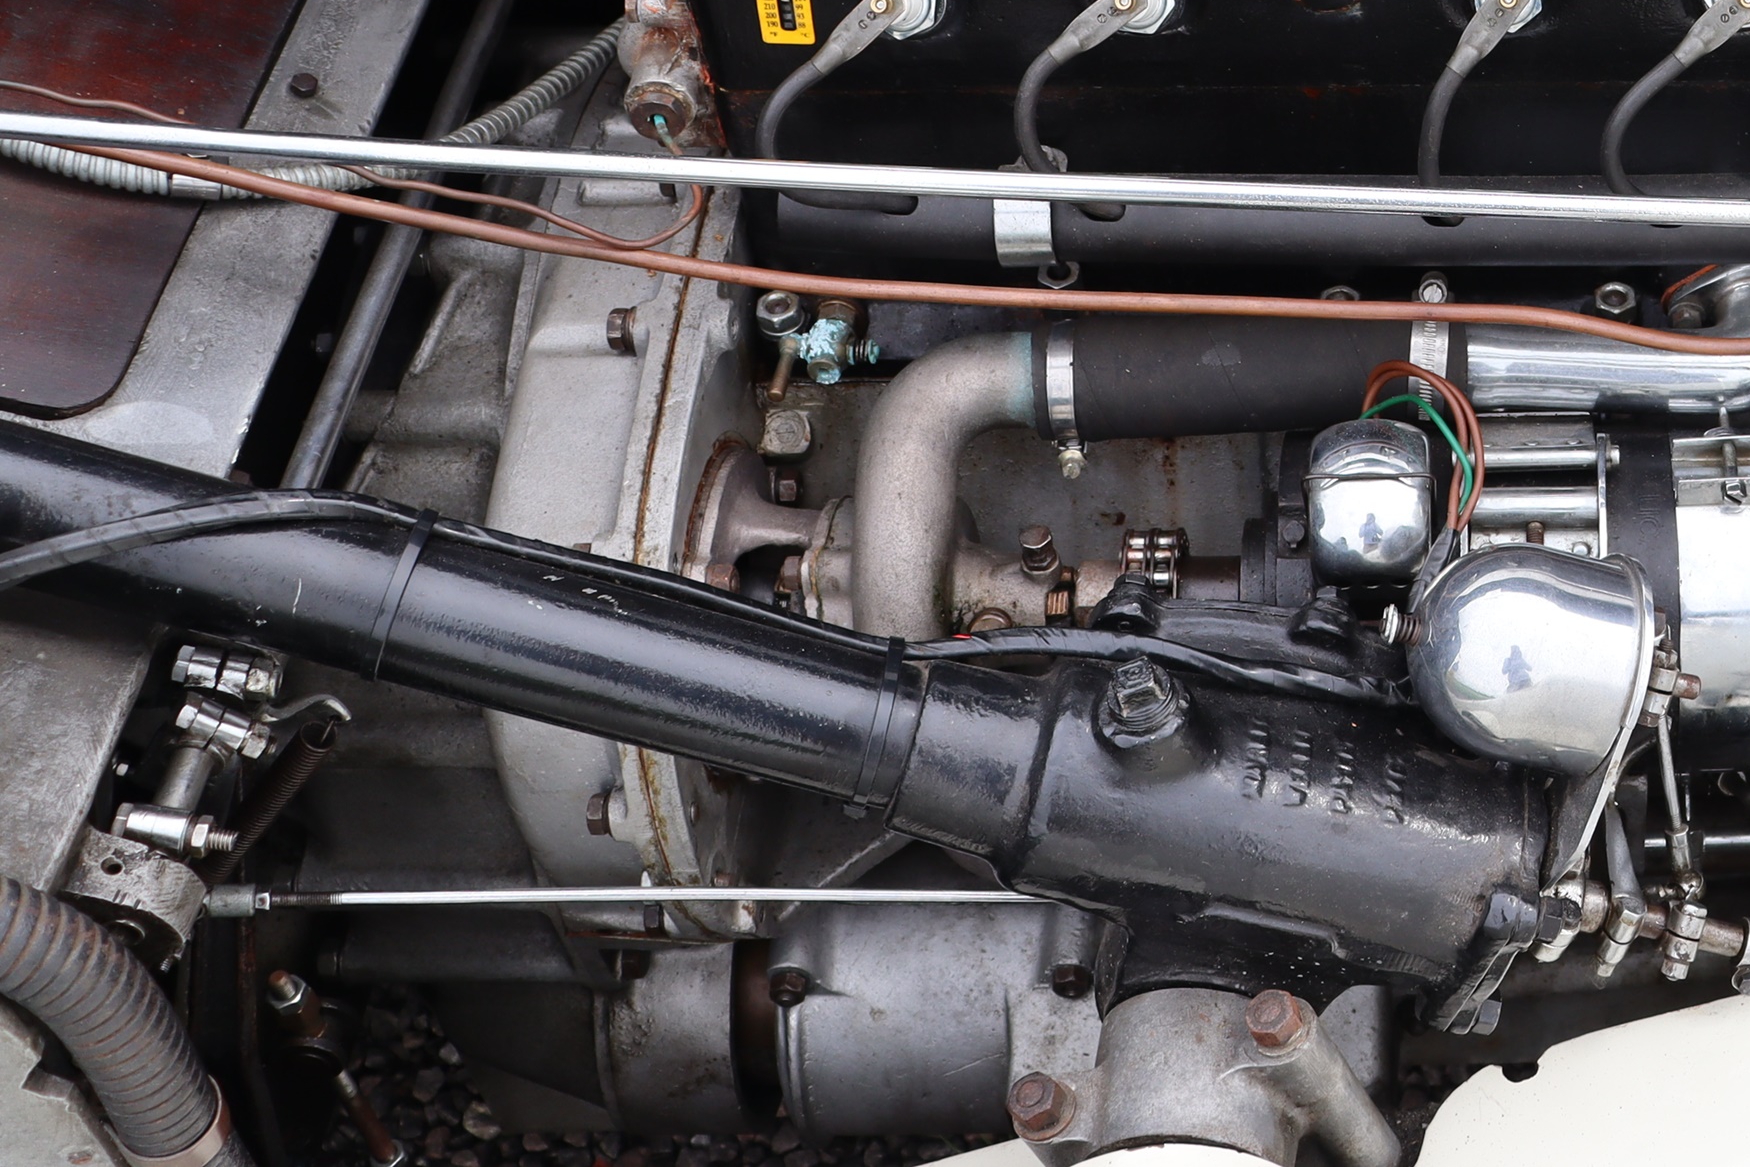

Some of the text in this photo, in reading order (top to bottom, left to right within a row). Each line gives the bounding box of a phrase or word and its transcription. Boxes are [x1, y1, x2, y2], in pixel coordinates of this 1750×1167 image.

[764, 2, 804, 11] 210 99
[797, 12, 805, 20] 93
[767, 20, 807, 29] 190 88
